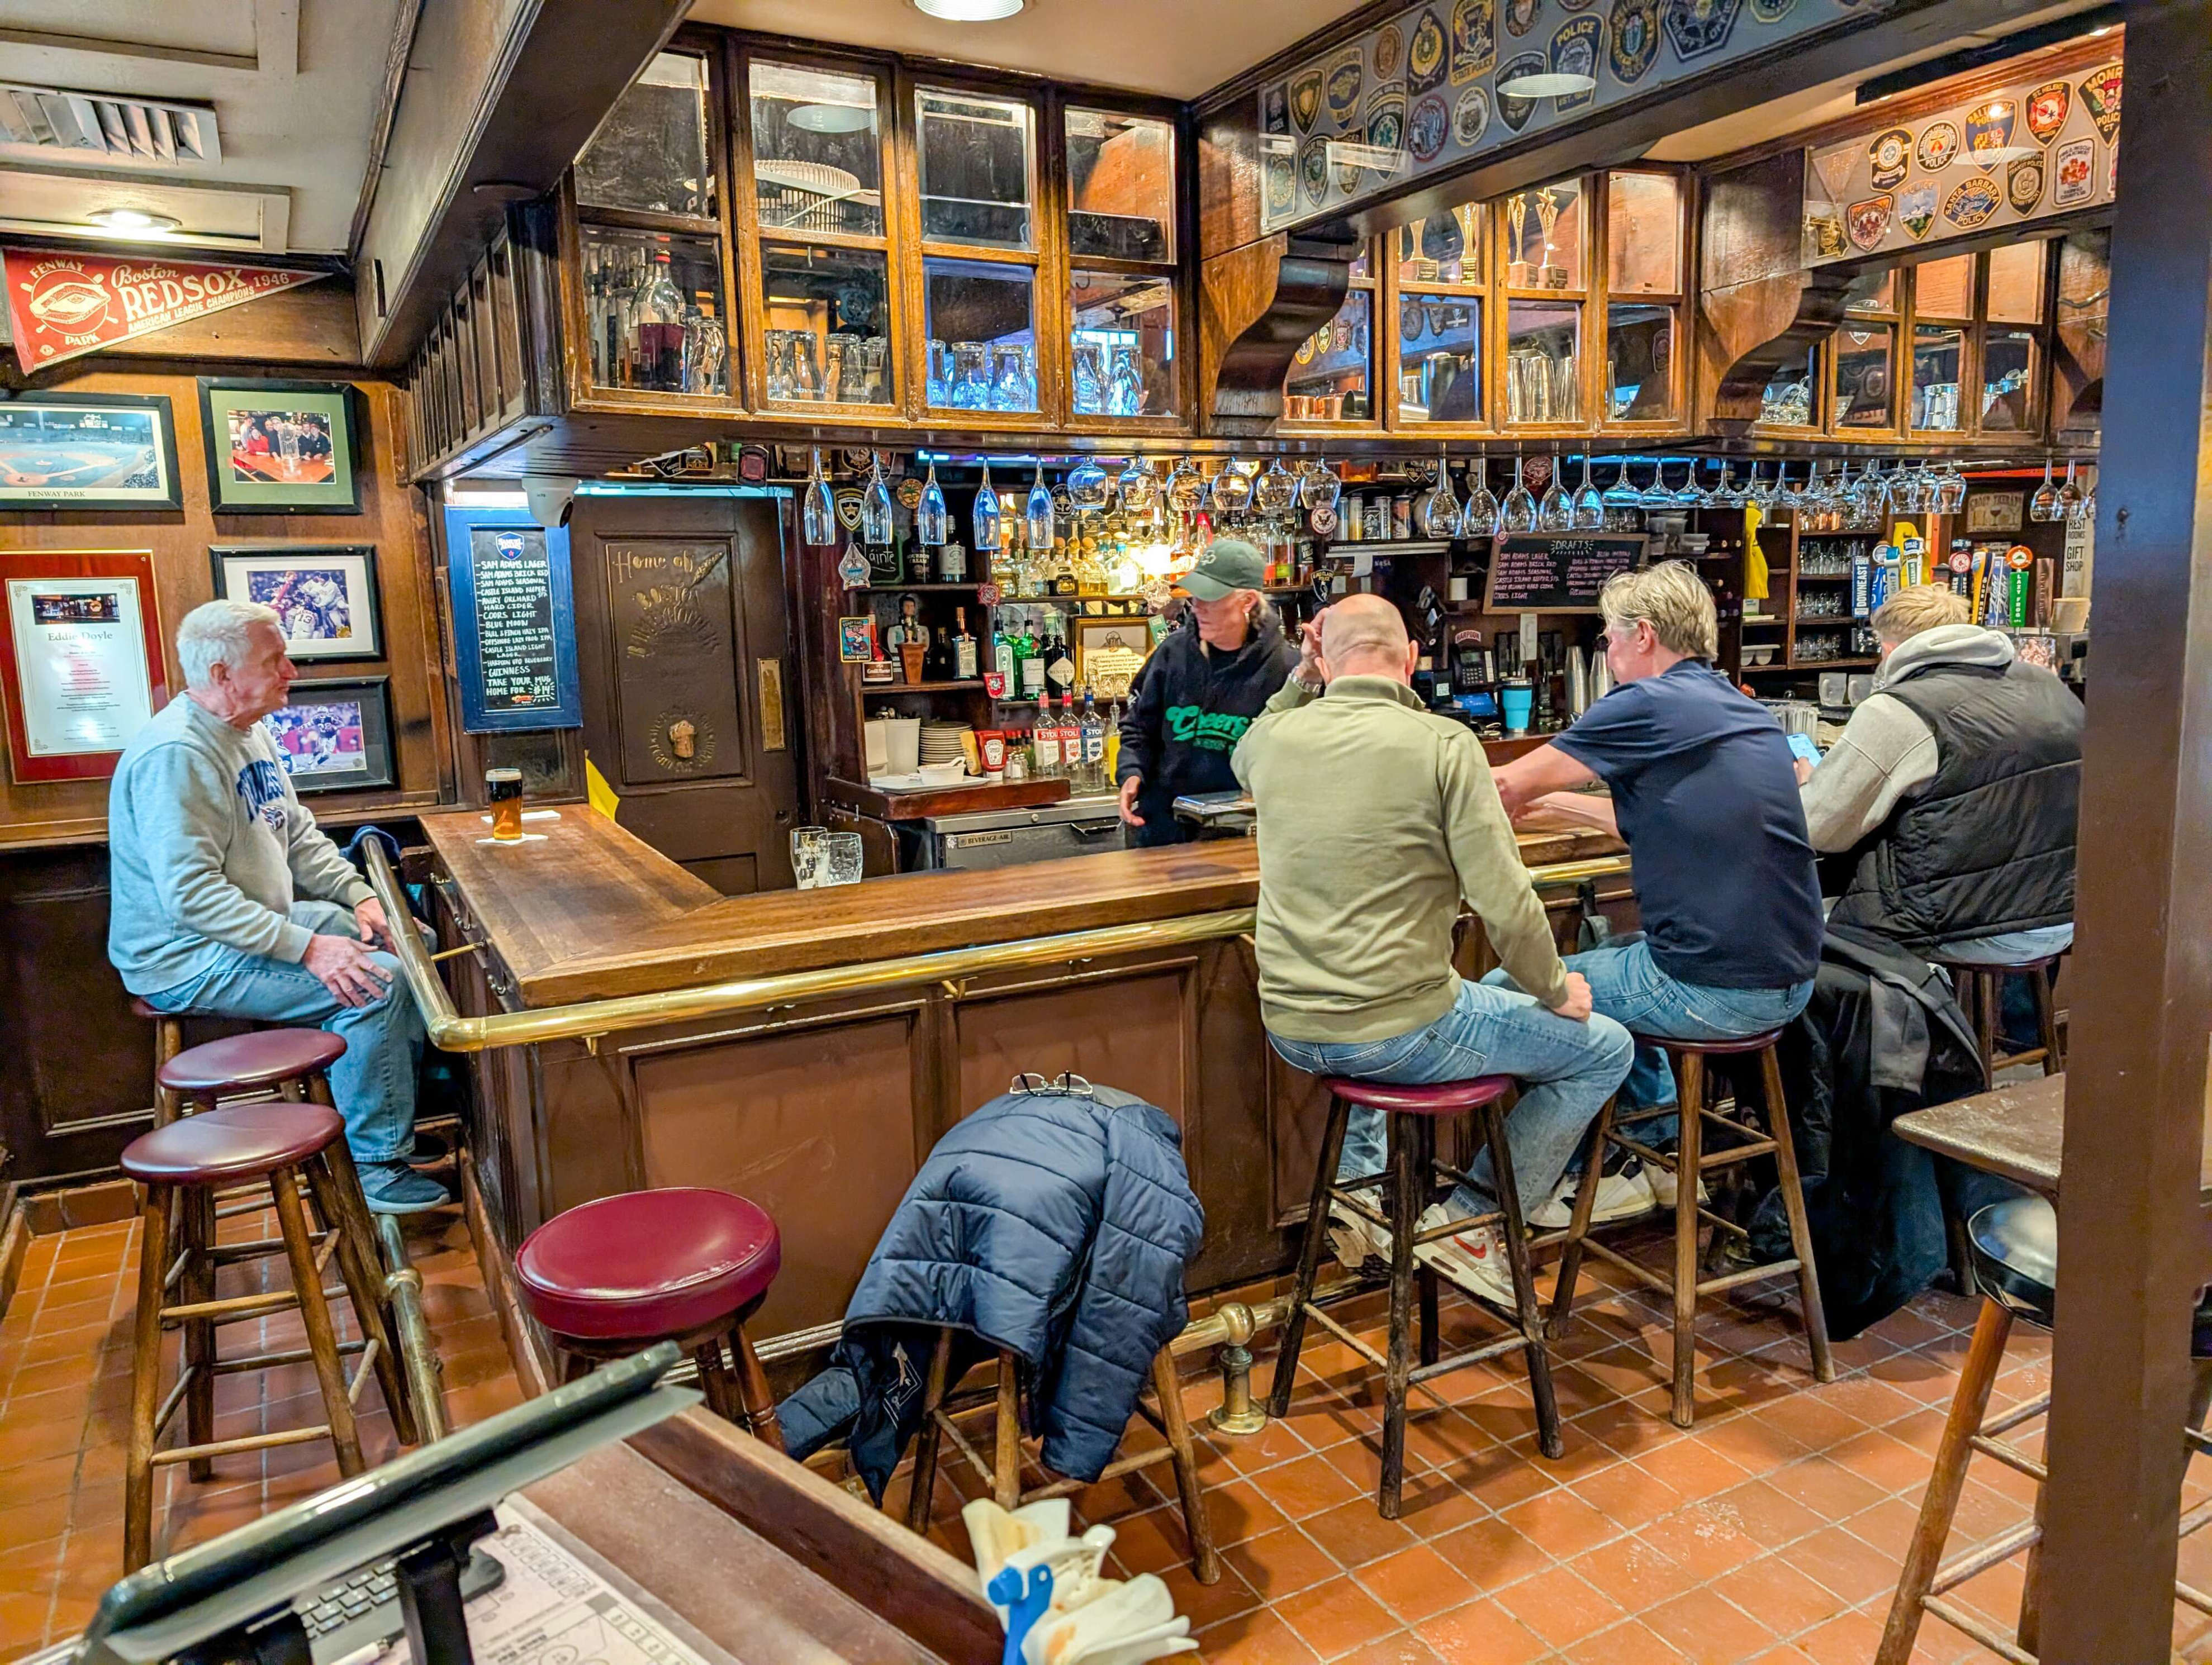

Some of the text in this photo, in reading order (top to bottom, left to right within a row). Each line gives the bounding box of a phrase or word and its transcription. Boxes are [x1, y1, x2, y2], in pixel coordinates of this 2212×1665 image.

[1556, 21, 1595, 46] POLICE
[2085, 66, 2123, 92] MONR
[2096, 112, 2120, 126] POLIC
[1925, 154, 1948, 168] POLICE
[1902, 182, 1934, 196] POLICE
[1945, 178, 2000, 215] SANTA BARBARA
[1957, 211, 1988, 225] POLICE
[30, 259, 84, 279] FENWAY
[111, 264, 179, 289] Boston
[253, 272, 289, 288] 1946
[128, 285, 255, 335] AMERICAN LEAGUE CHAMPIONS
[65, 333, 101, 346] PARK
[2068, 517, 2086, 530] REST
[2068, 531, 2085, 539] ROOMS
[1555, 540, 1589, 550] DRAFTS
[2067, 546, 2085, 559] GIFT
[481, 560, 548, 570] SAM ADAMS LAGER
[613, 550, 667, 583] Home
[2066, 561, 2083, 572] SHOP
[480, 571, 493, 579] SAM
[494, 570, 513, 579] ADAMS
[1857, 565, 1867, 607] DOWNEAST
[504, 595, 537, 603] ORCHARD
[298, 613, 313, 625] 13
[48, 630, 113, 642] Eddie Doyle
[1456, 631, 1479, 640] HARPOON
[488, 665, 531, 677] GUINNESS
[486, 675, 552, 687] TAKE YOUR MUG
[486, 687, 509, 696] HOME
[533, 685, 551, 695] $14
[1166, 706, 1249, 737] Cheers
